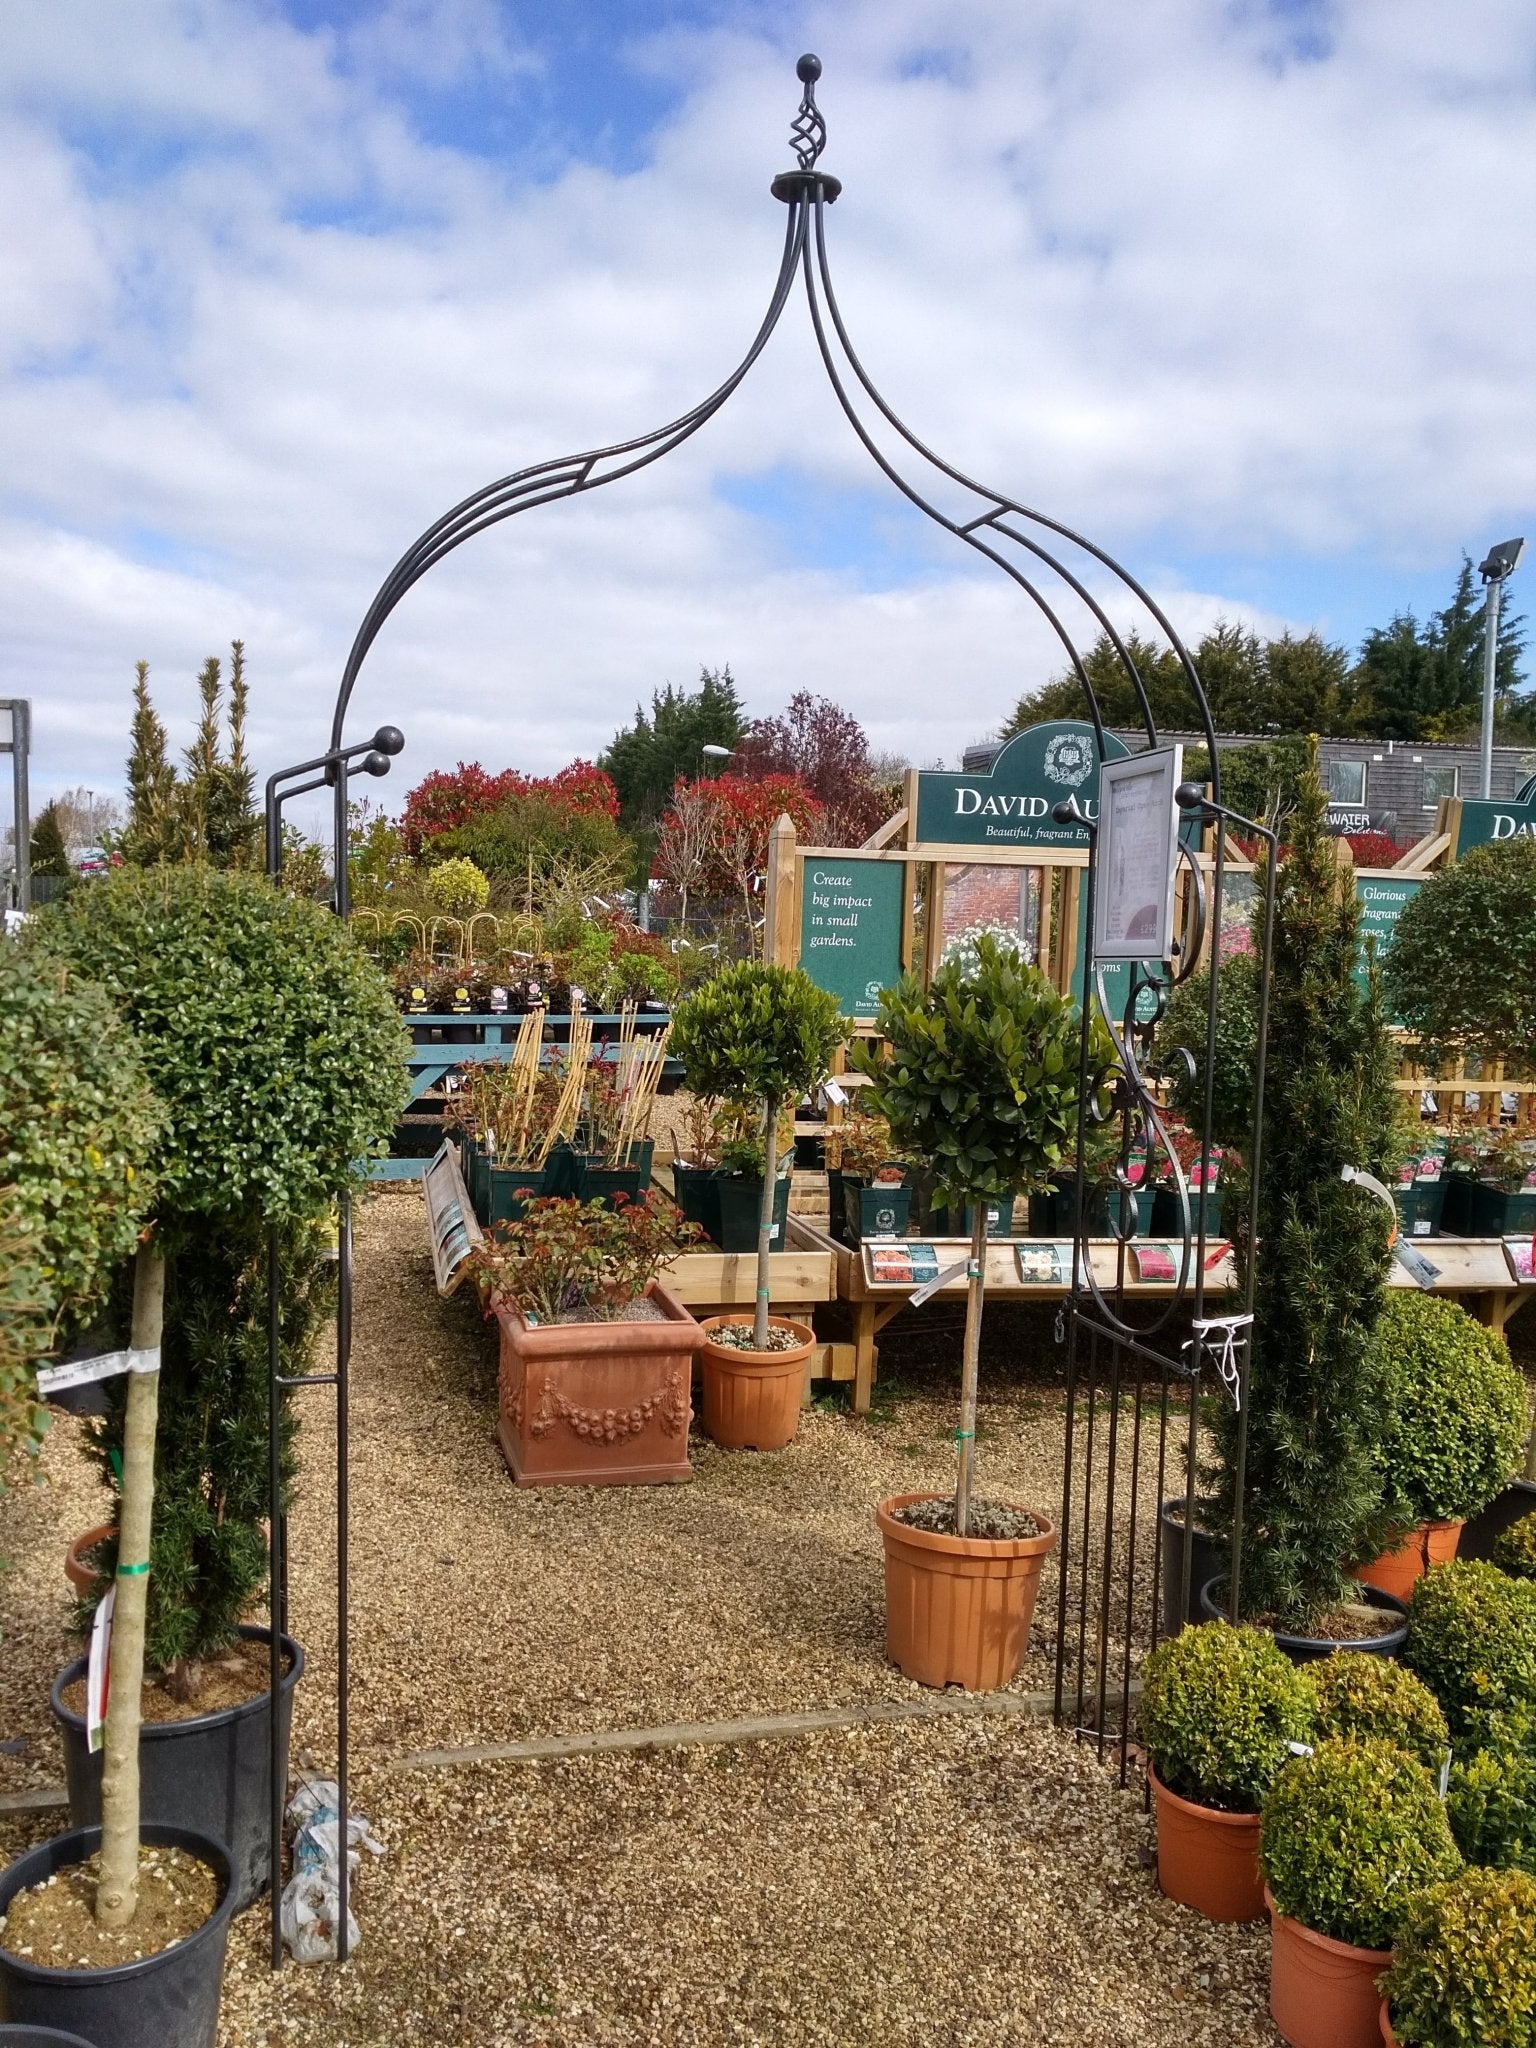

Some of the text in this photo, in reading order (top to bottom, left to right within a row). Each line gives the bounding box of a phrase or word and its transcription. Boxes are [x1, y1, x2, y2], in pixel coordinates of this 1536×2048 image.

[954, 788, 1048, 817] DAVID
[985, 825, 1033, 839] Beautiful,
[1035, 826, 1073, 840] fragrant
[813, 871, 852, 886] Create
[812, 891, 873, 909] big impact
[1363, 887, 1407, 901] Glorious
[812, 913, 858, 927] in small
[1362, 905, 1401, 920] fragran
[809, 932, 857, 948] gardens.
